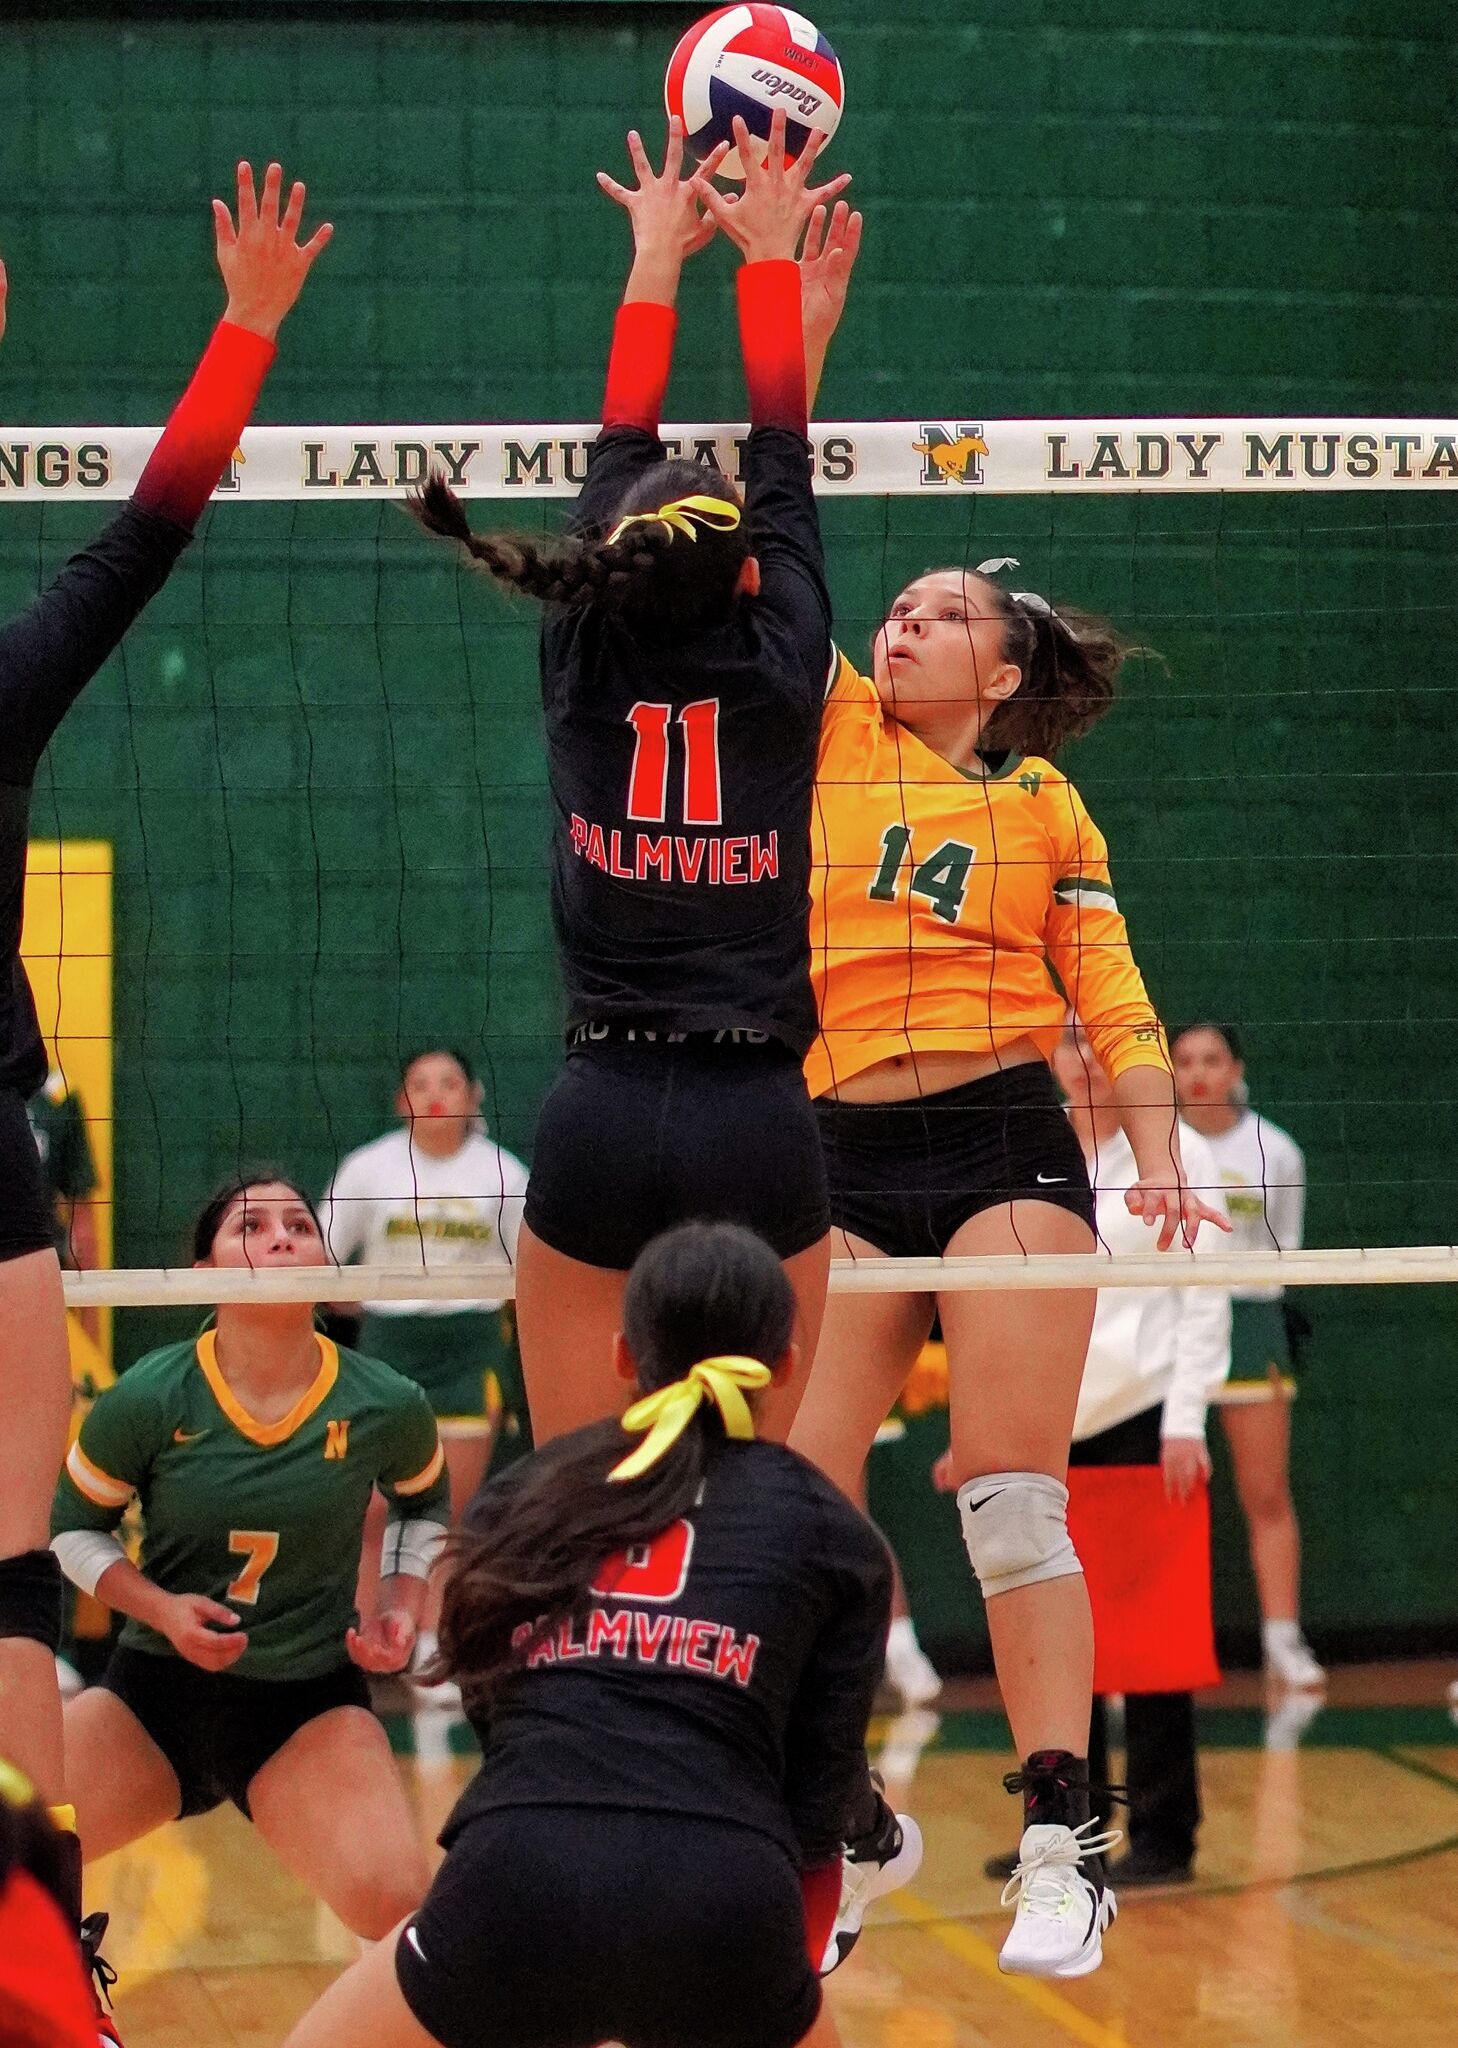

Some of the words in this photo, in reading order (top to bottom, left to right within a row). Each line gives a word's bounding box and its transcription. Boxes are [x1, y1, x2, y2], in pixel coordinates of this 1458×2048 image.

[751, 69, 823, 117] Baden
[303, 441, 481, 488] LADY
[1045, 433, 1224, 480] LADY
[1243, 433, 1458, 480] MUSTA
[626, 698, 722, 825] 11
[569, 813, 778, 884] PALMVIEW
[866, 822, 977, 926] 14
[324, 1420, 350, 1459] N
[226, 1530, 280, 1605] 7
